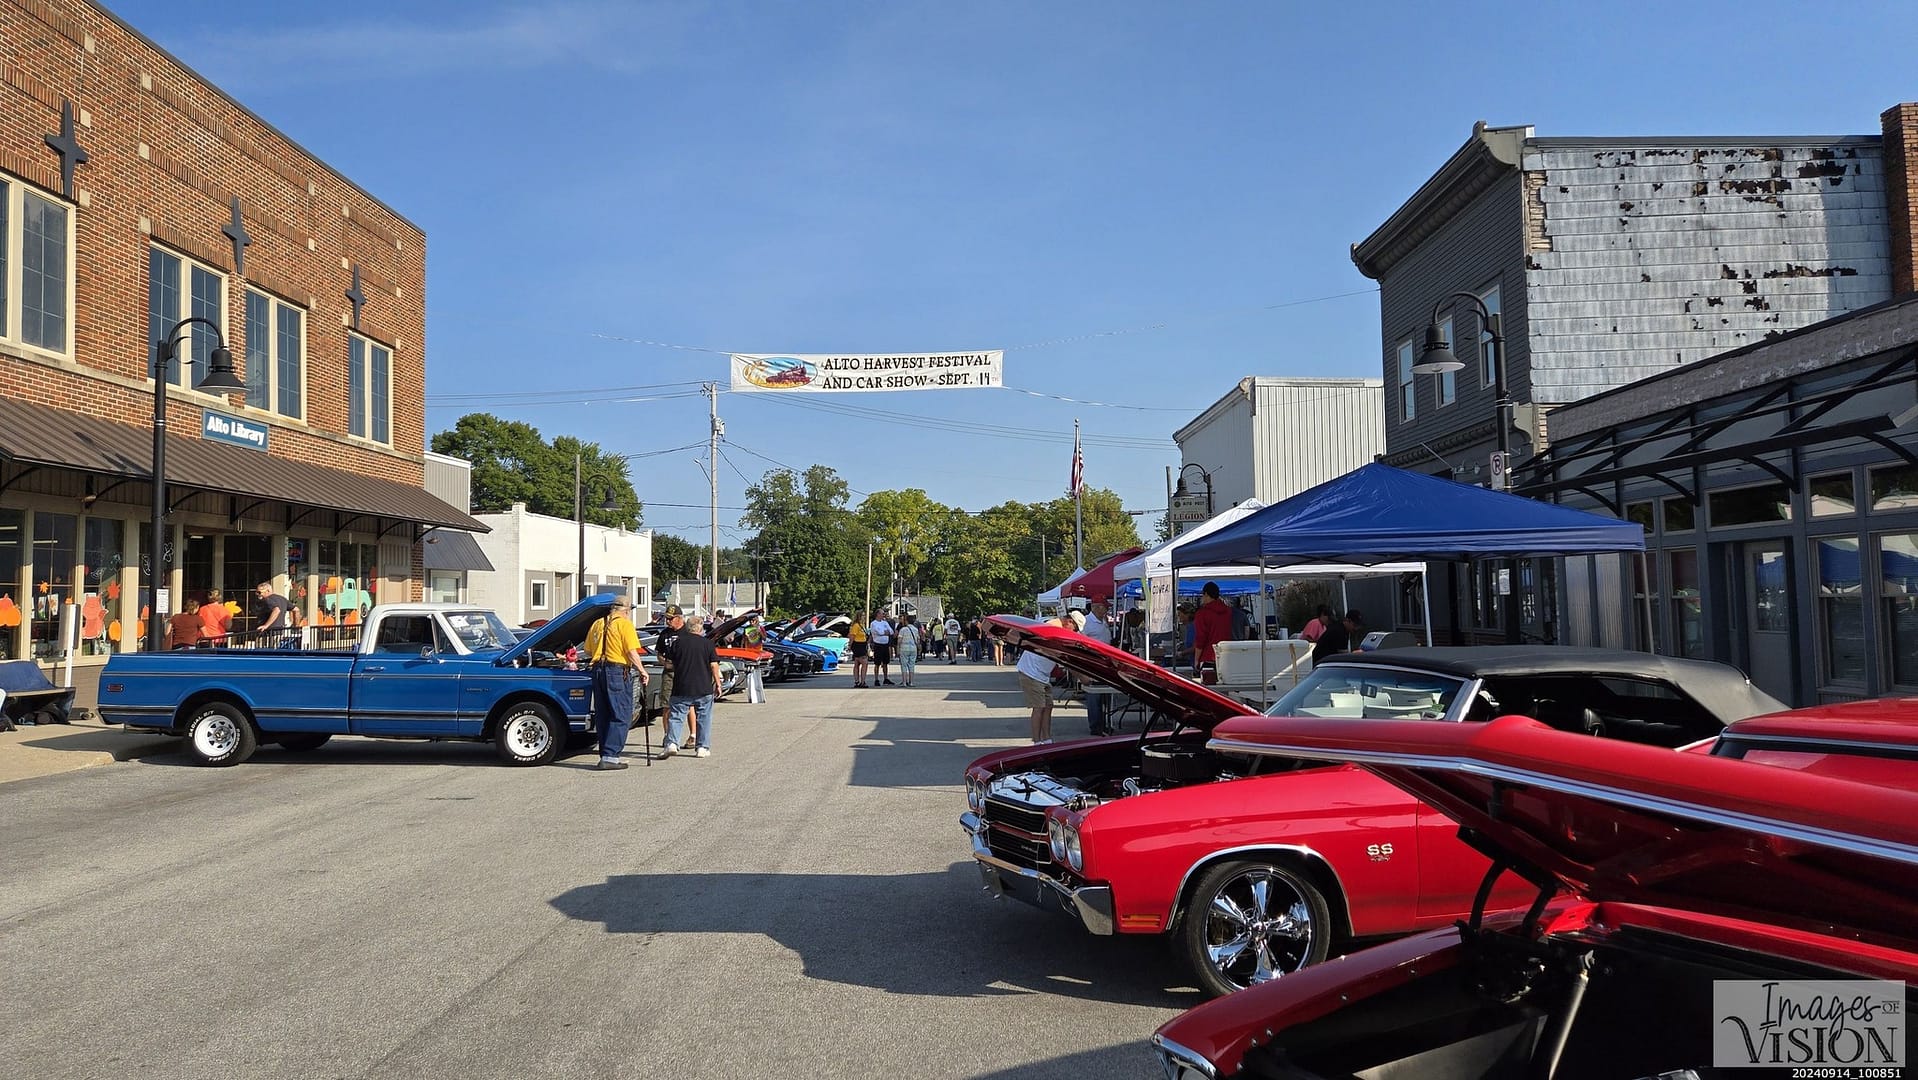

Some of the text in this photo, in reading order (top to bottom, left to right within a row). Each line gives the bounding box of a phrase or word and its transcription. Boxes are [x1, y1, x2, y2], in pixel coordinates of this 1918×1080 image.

[824, 355, 991, 370] ALTO HARVEST FESTIVAL
[823, 376, 852, 389] AND
[856, 376, 883, 389] CAR
[886, 375, 927, 388] SHOW
[938, 373, 973, 385] SEPT.
[207, 416, 265, 445] Alto Library
[1173, 513, 1206, 521] LEGION
[1367, 843, 1394, 856] SS
